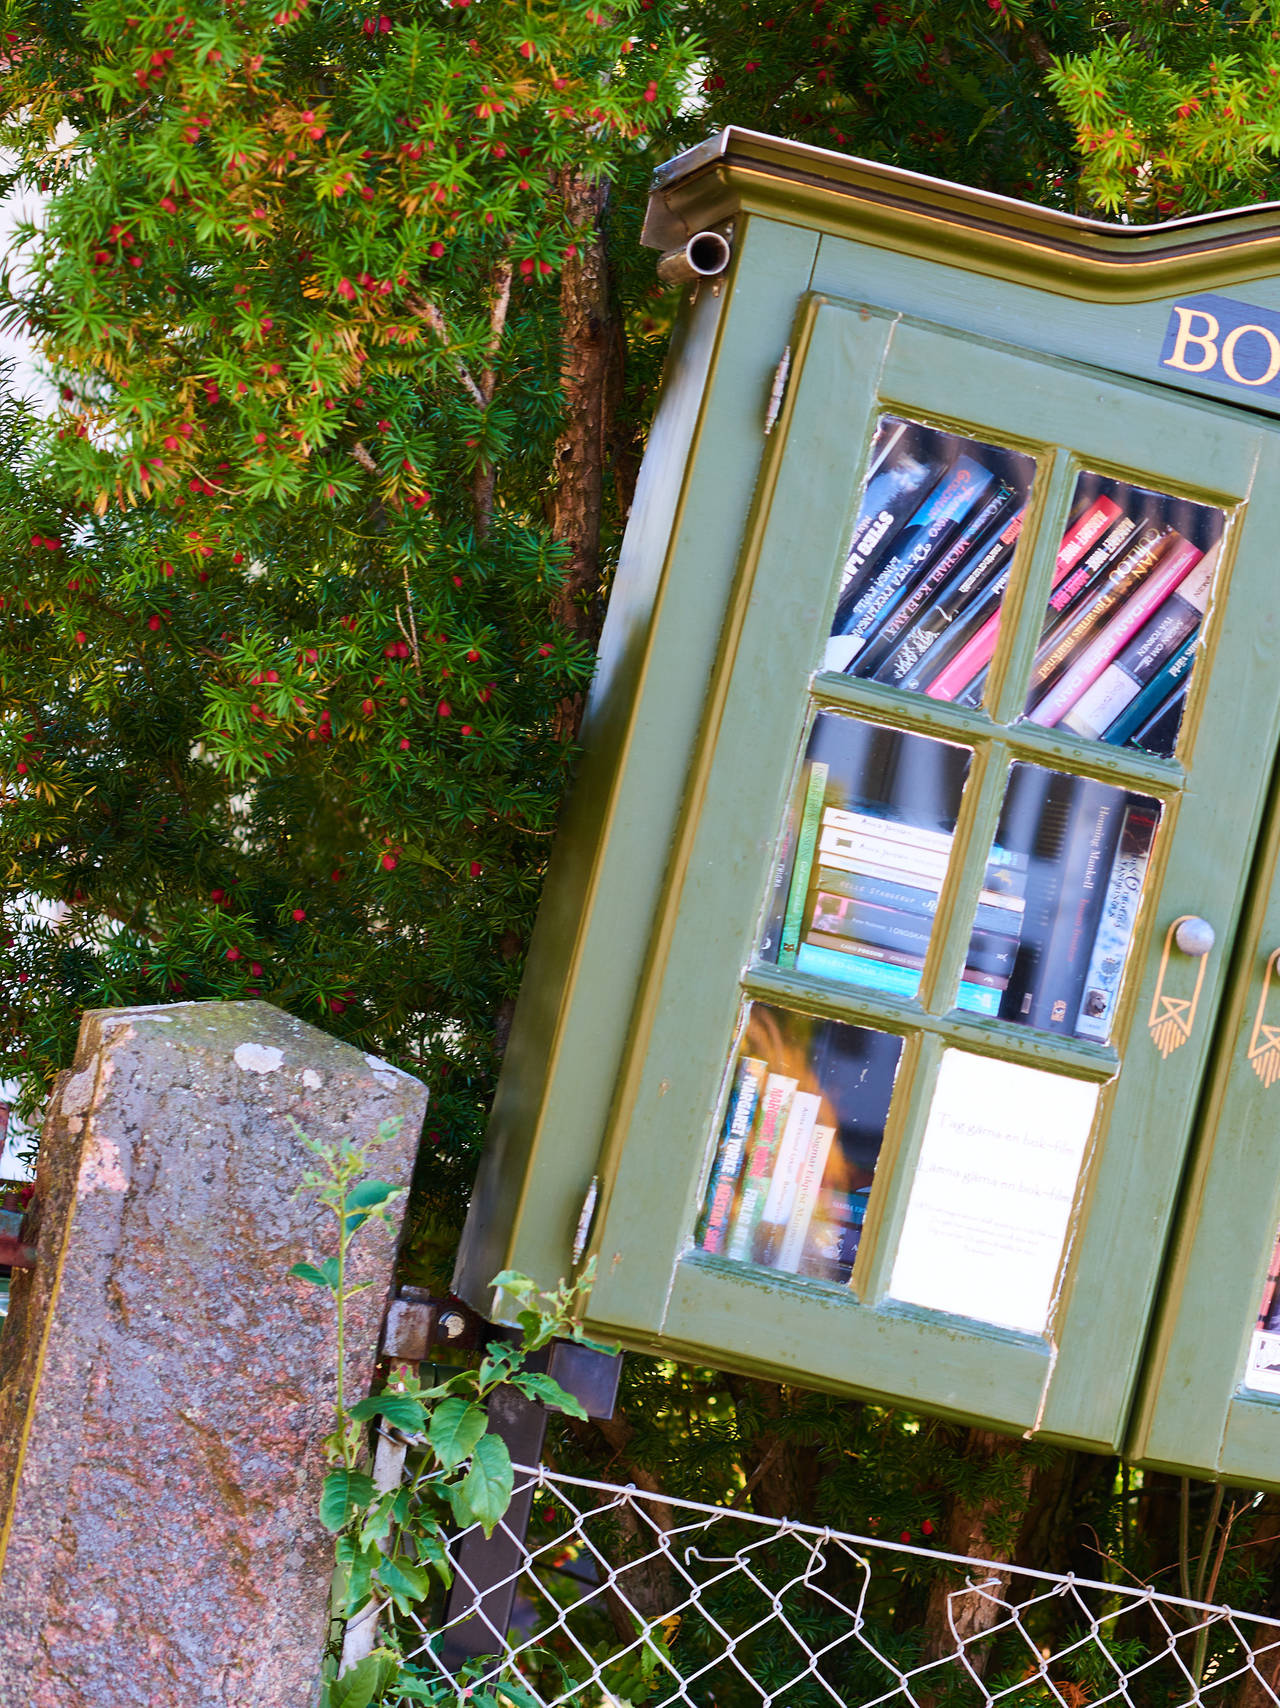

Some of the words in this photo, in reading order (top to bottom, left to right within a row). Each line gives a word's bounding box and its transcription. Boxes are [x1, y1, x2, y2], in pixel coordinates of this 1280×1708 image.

[854, 508, 896, 557] STIEG
[928, 536, 970, 584] MICHAEL
[1105, 524, 1162, 586] GUILLOU
[1130, 550, 1159, 580] JAN
[1069, 590, 1115, 640] Tjuvarnas
[1111, 602, 1145, 637] DAN
[1036, 634, 1077, 679] marknad
[1081, 635, 1119, 676] FÖRE
[1149, 641, 1164, 657] OM
[1167, 654, 1189, 677] värld
[1051, 673, 1084, 708] DAN
[1088, 804, 1110, 848] Henning
[1081, 848, 1101, 889] Mankell
[729, 1073, 759, 1137] MARGARET
[757, 1086, 784, 1143] MARGARET
[718, 1136, 743, 1177] YORKE
[736, 1187, 759, 1225] FARLIG
